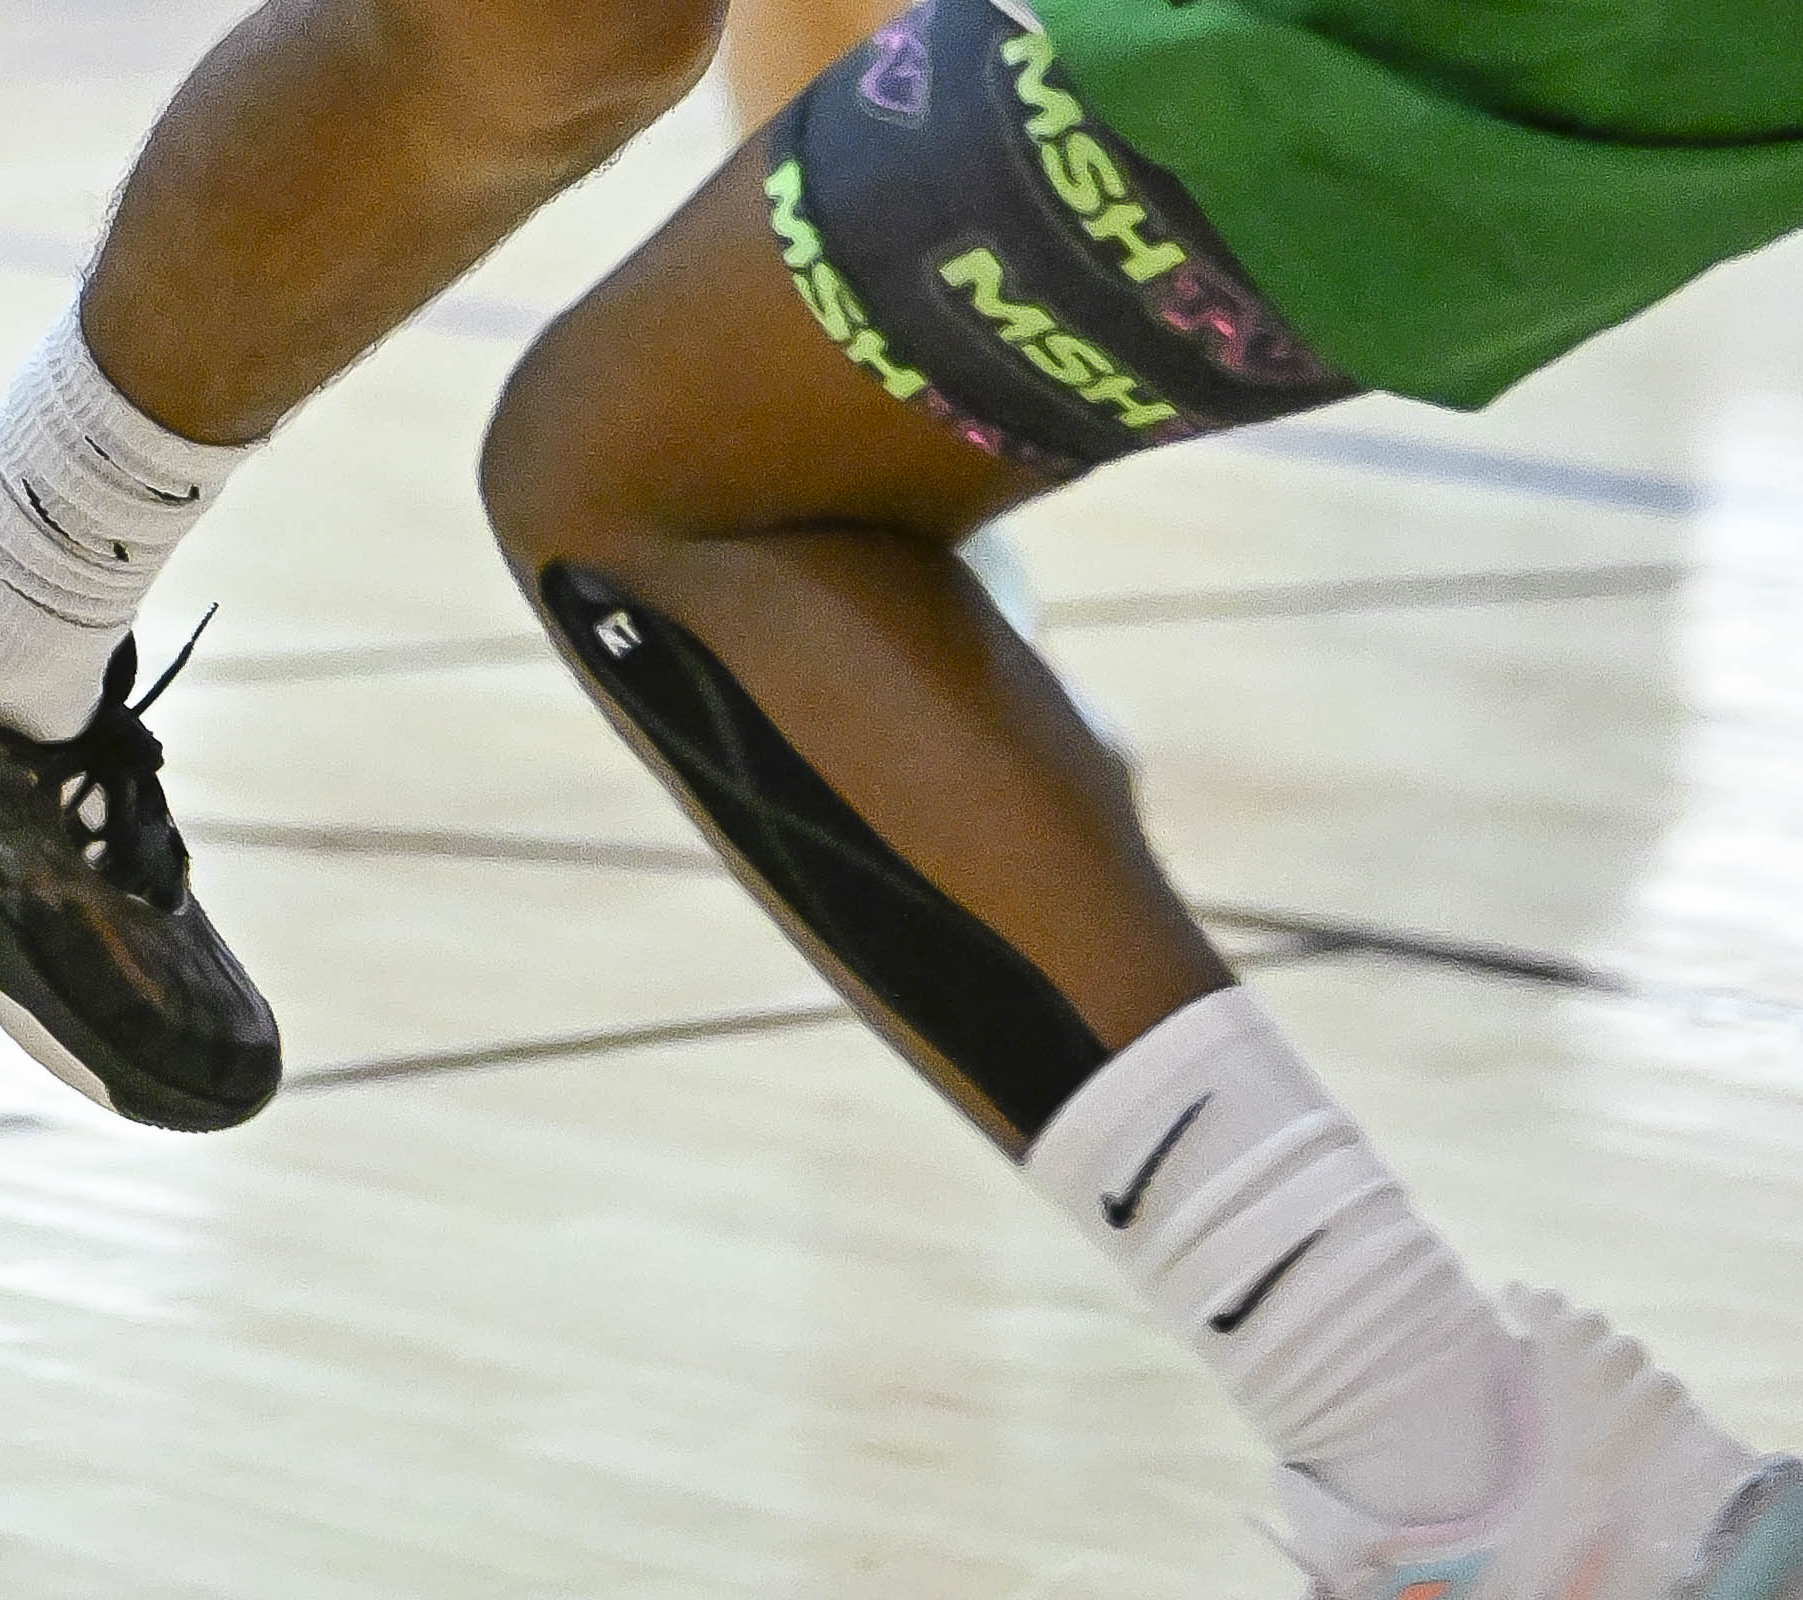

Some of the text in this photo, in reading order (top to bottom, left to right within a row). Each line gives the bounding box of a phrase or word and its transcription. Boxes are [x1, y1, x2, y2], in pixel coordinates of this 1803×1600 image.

[1000, 30, 1187, 284] MSH
[763, 160, 927, 401] MSH
[938, 247, 1178, 429] MSH
